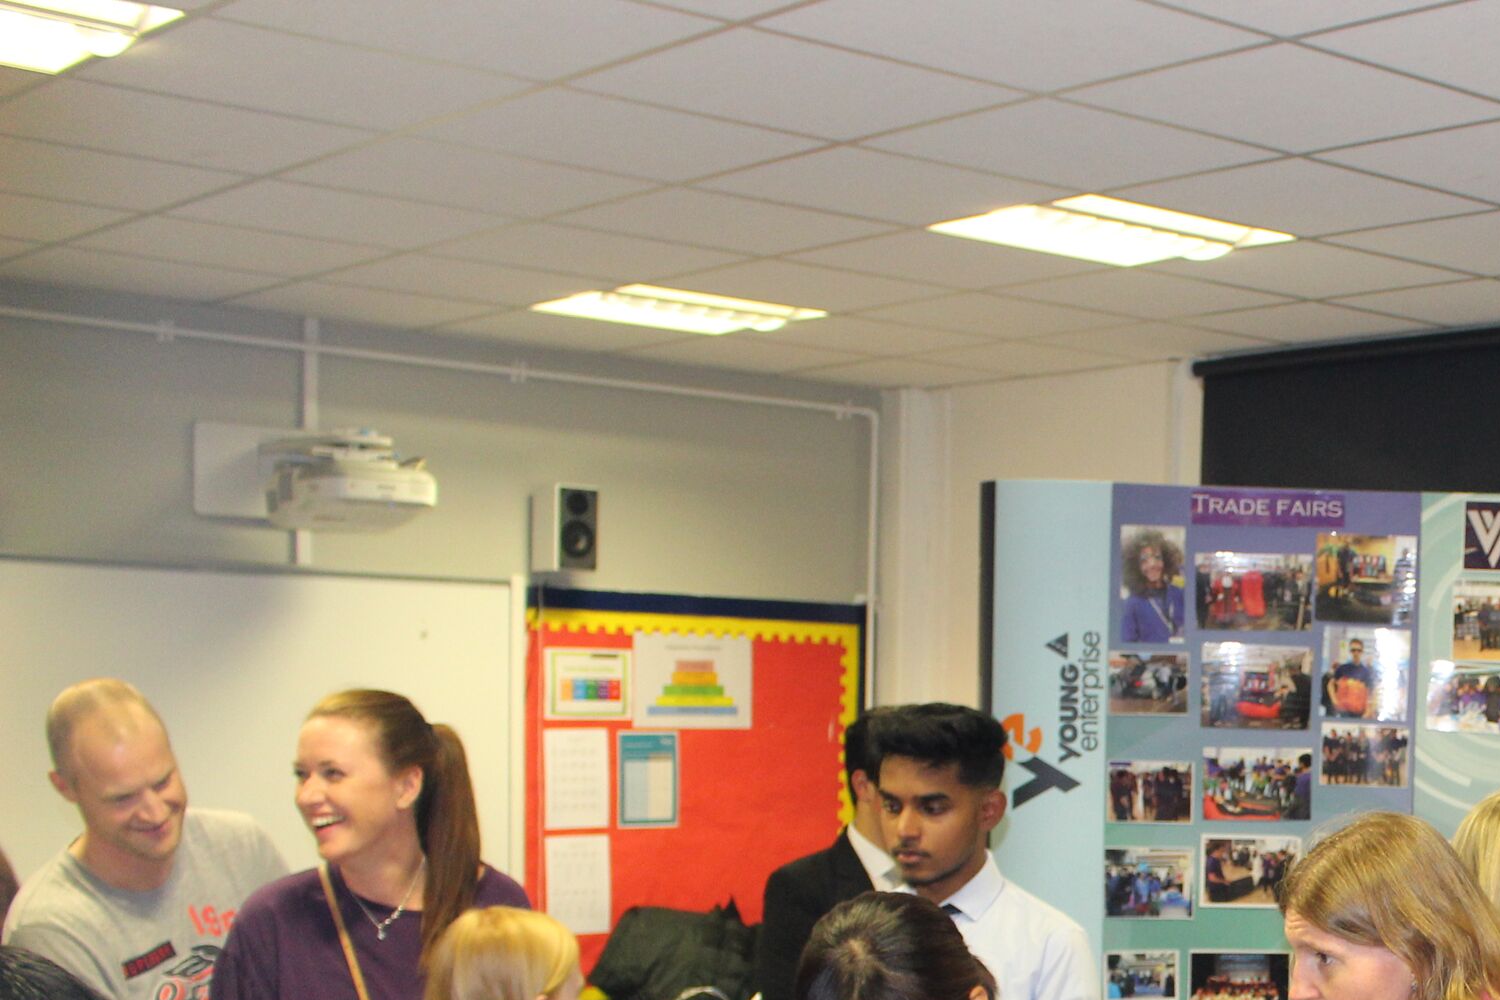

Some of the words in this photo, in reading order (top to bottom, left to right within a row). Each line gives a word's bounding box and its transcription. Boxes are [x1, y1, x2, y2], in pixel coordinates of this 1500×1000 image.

[1192, 493, 1270, 517] TRADE
[1276, 497, 1344, 518] FAIRS
[1078, 630, 1104, 752] enterprise
